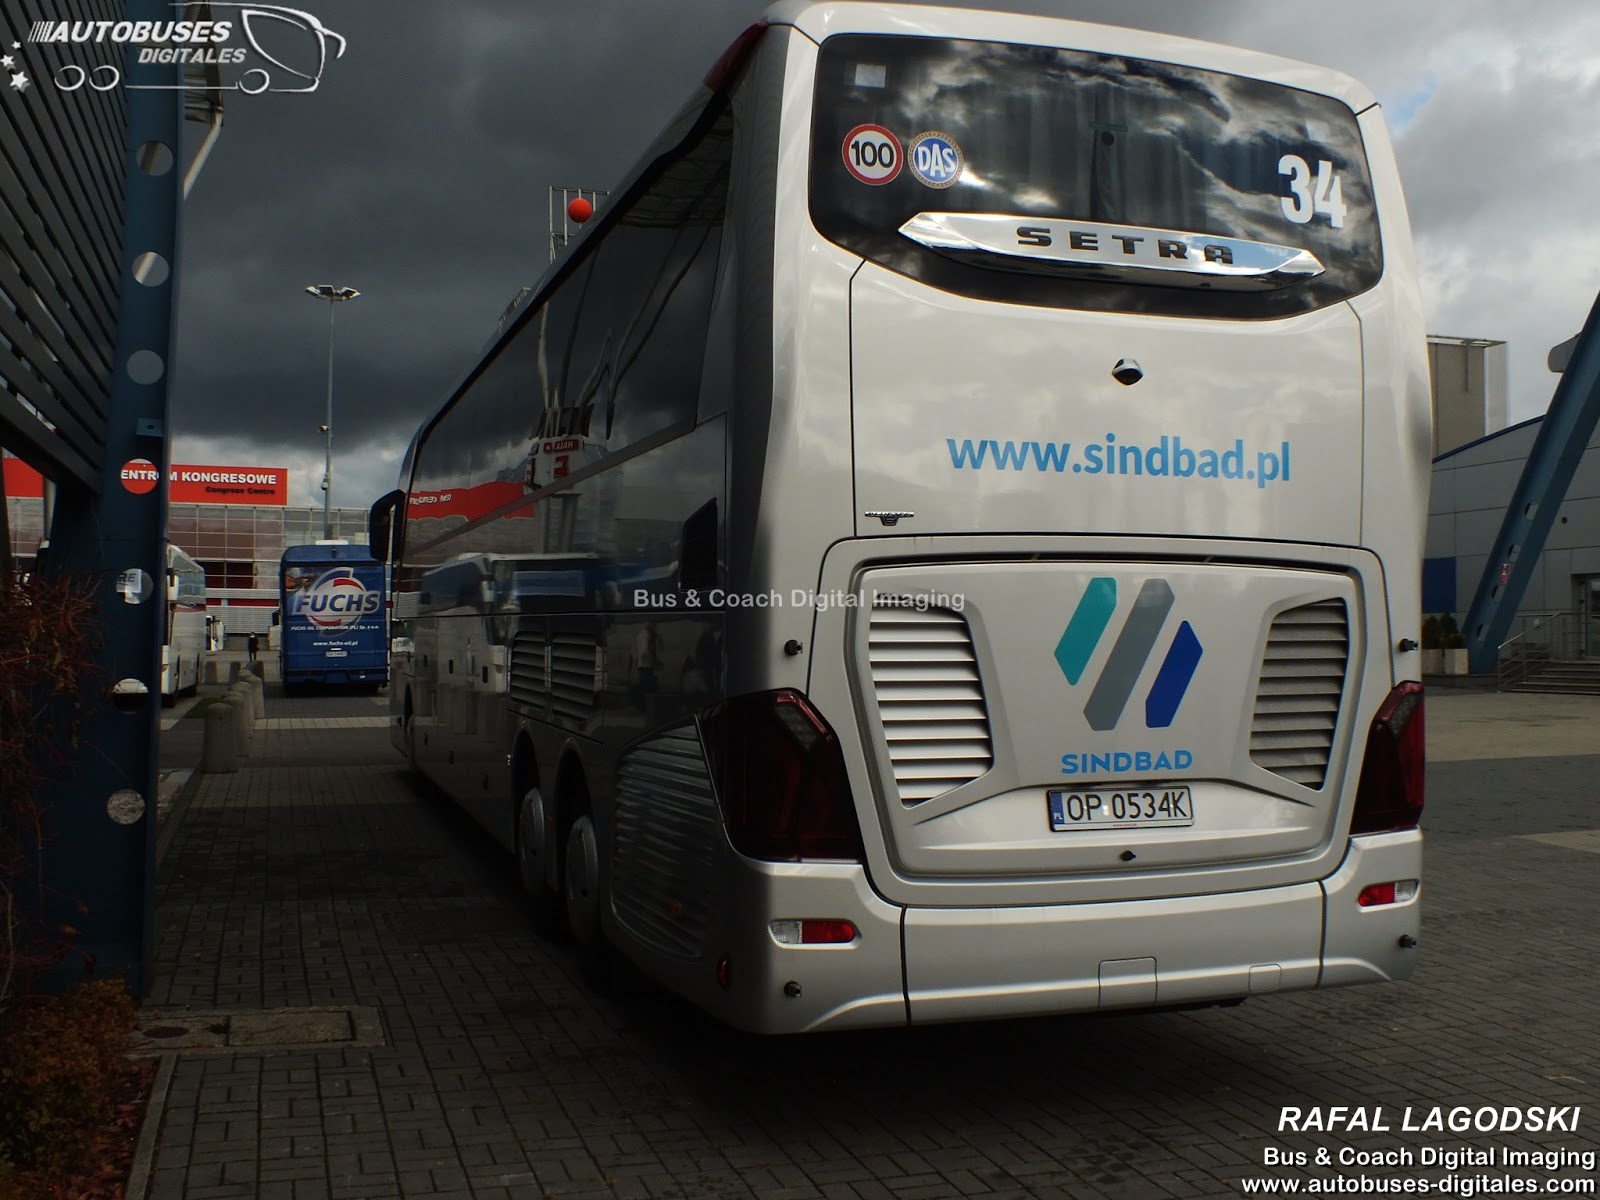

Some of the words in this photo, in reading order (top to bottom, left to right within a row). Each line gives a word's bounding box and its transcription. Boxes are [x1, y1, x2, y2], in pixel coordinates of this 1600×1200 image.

[851, 140, 895, 168] 100
[917, 143, 957, 178] DAS
[1278, 154, 1348, 229] 34
[1016, 226, 1235, 265] SETRA
[946, 432, 1291, 489] www.sindbad.pl
[181, 471, 277, 485] KONGRESOWE
[296, 593, 379, 613] FUCHS
[1061, 750, 1193, 774] SINDBAD
[1053, 812, 1063, 820] PL
[1067, 794, 1102, 822] OP
[1111, 791, 1188, 820] 0534K
